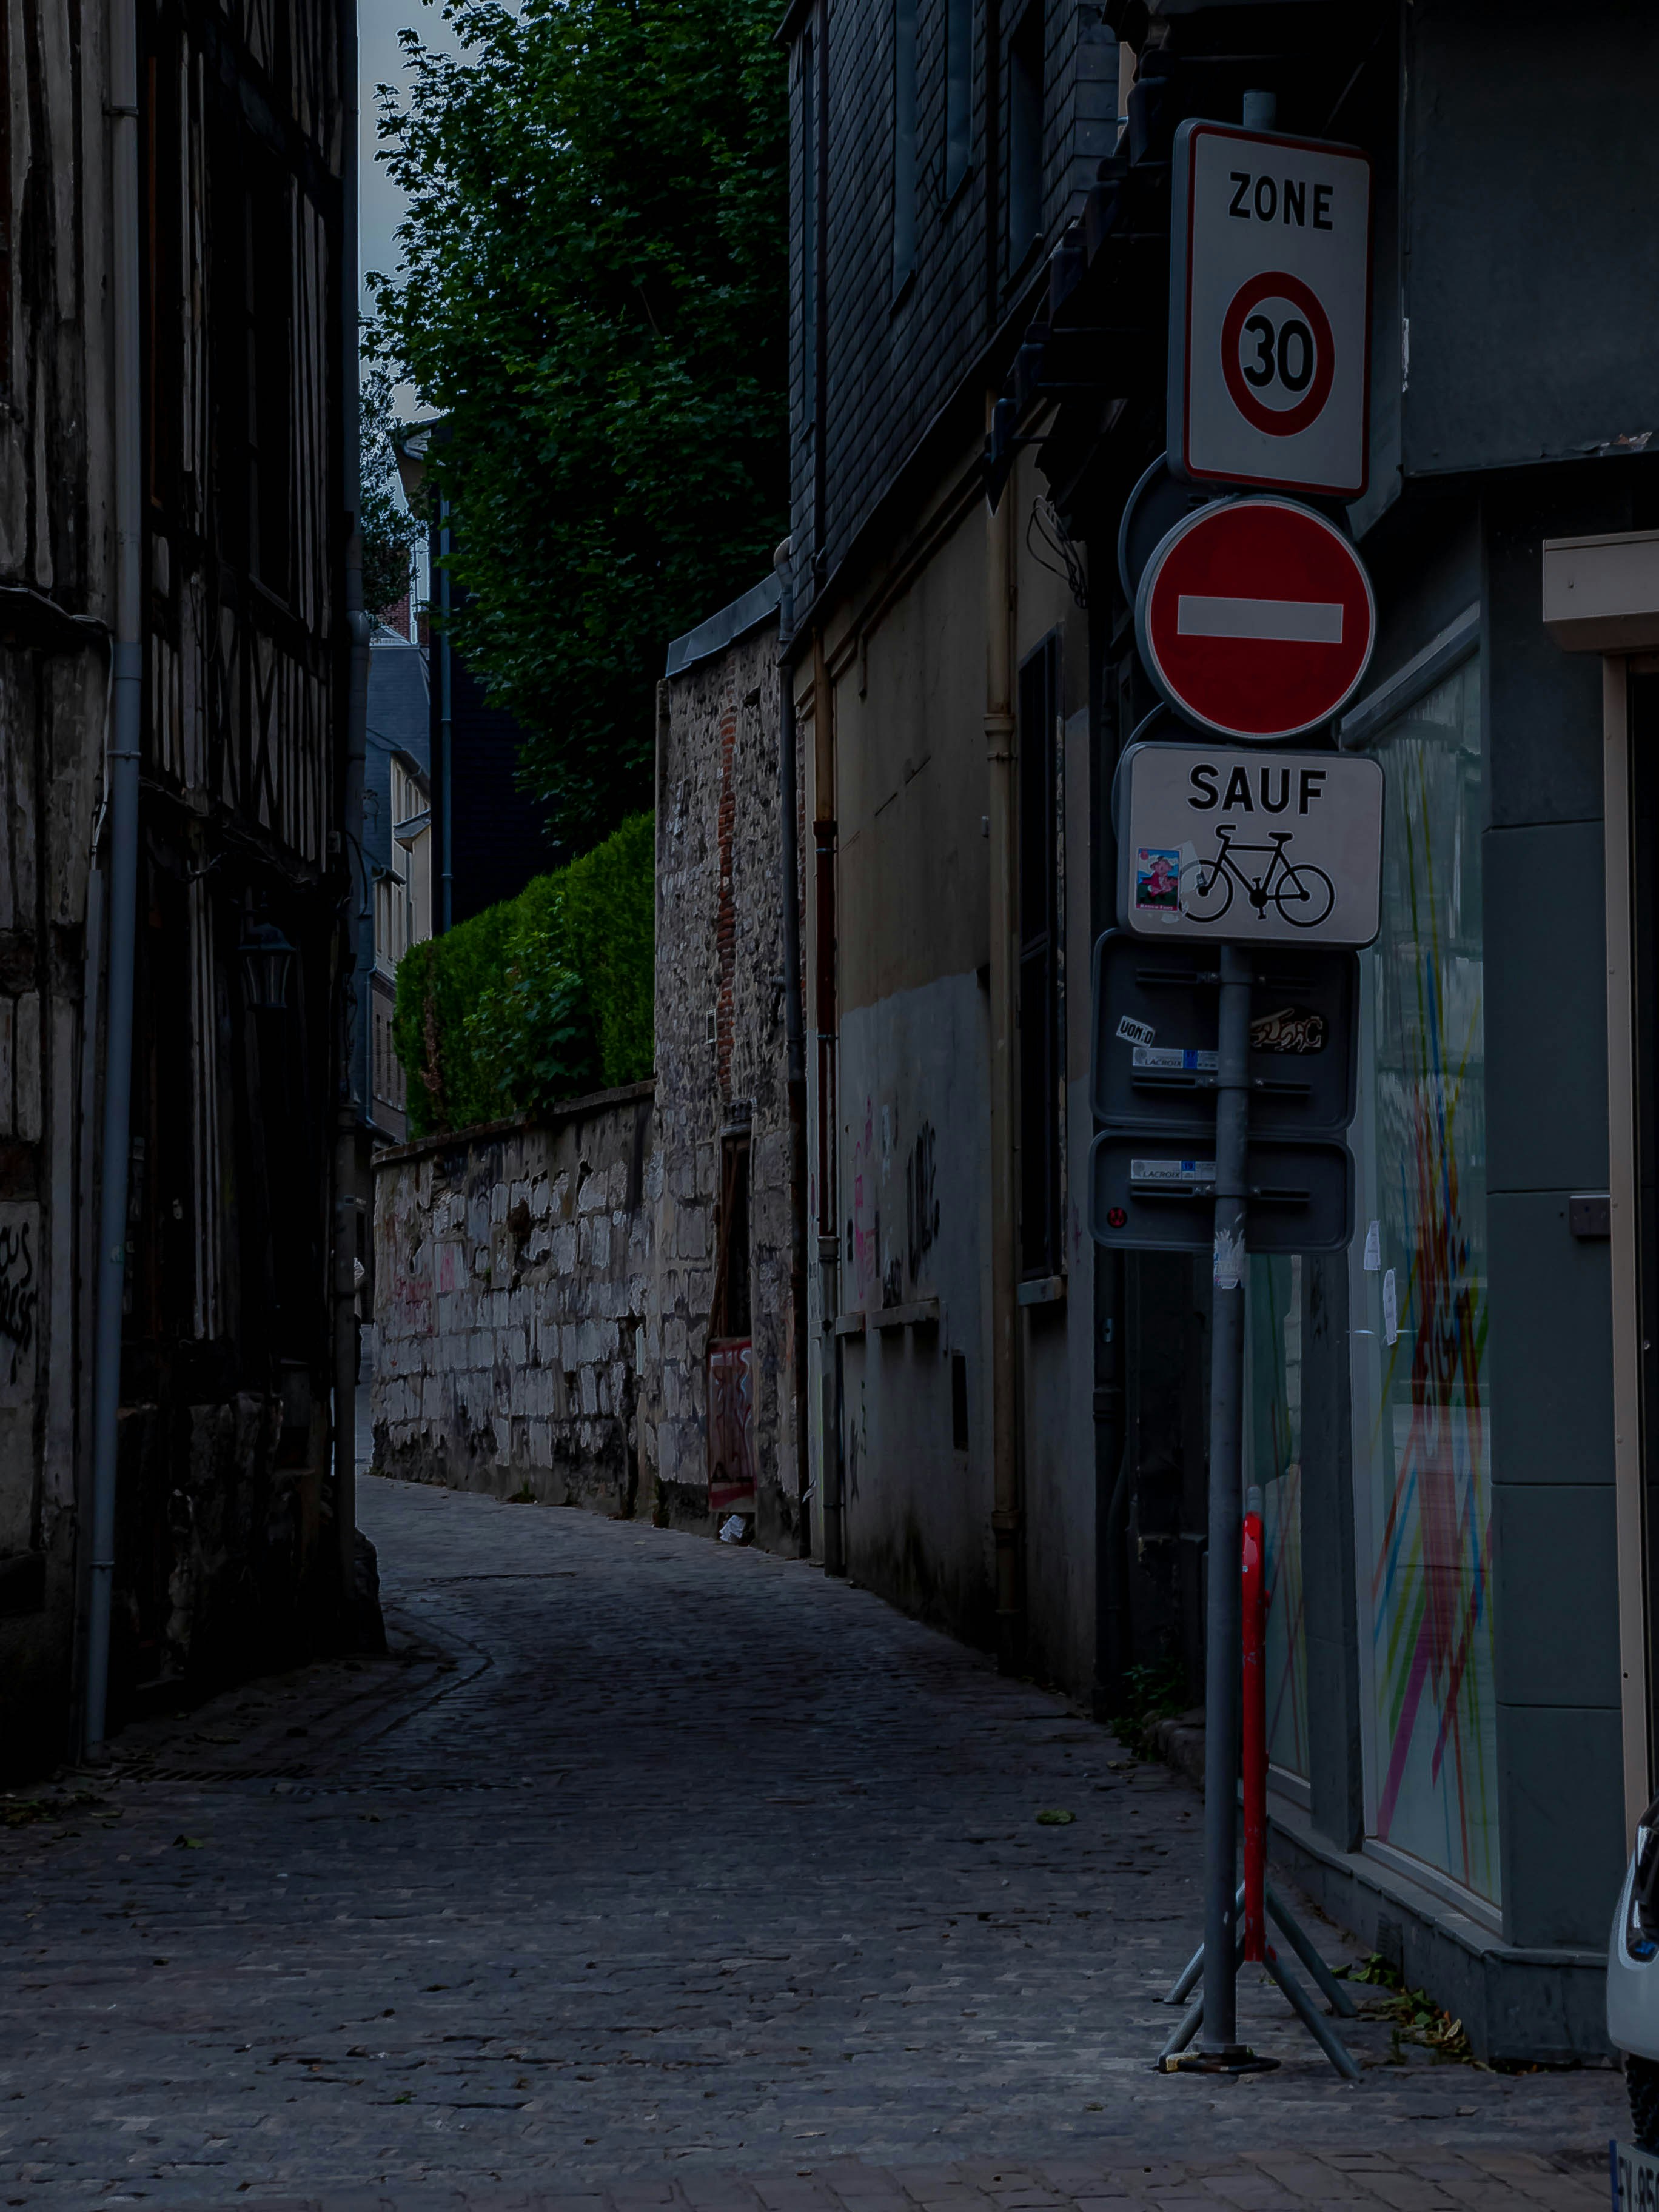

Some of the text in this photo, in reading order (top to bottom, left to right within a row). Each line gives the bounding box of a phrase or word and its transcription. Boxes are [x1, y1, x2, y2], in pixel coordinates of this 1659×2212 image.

[1229, 170, 1334, 230] ZONE
[1243, 314, 1313, 392] 30
[1187, 763, 1327, 814] SAUF
[1144, 1057, 1182, 1067] LACROIX
